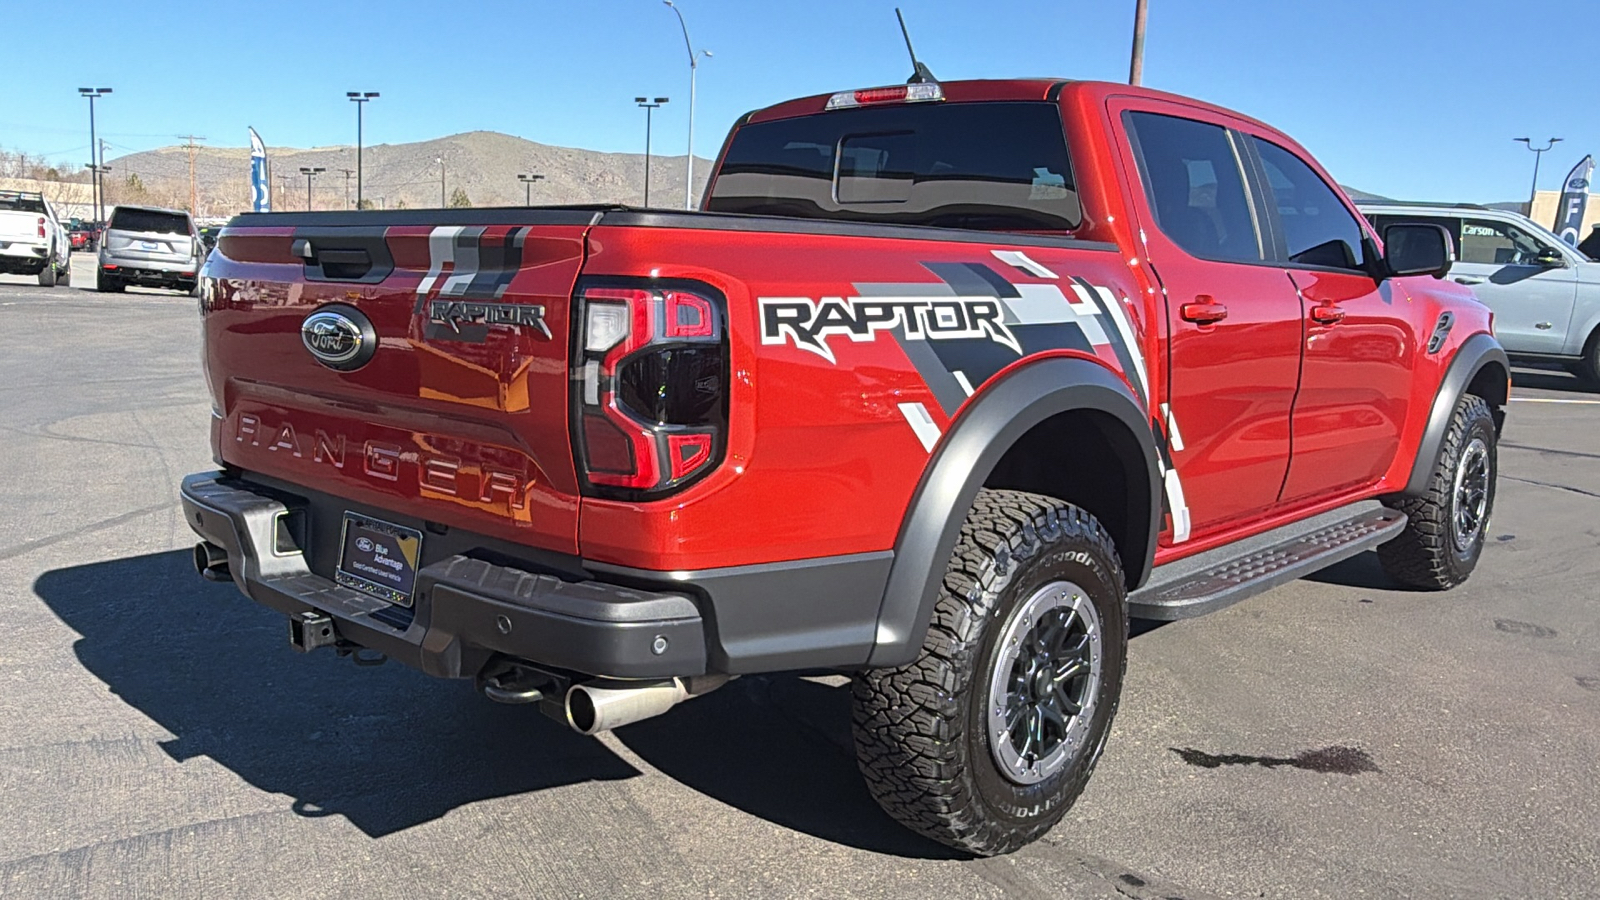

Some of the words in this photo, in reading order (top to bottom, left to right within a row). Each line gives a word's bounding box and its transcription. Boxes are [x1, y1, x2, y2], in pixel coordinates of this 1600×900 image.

[1463, 225, 1494, 236] Carson
[430, 301, 552, 340] RAPTOR
[758, 297, 1022, 365] RAPTOR
[311, 322, 344, 350] Ford
[236, 412, 527, 510] RANGER
[374, 554, 403, 570] Advantage
[375, 544, 388, 555] Blue
